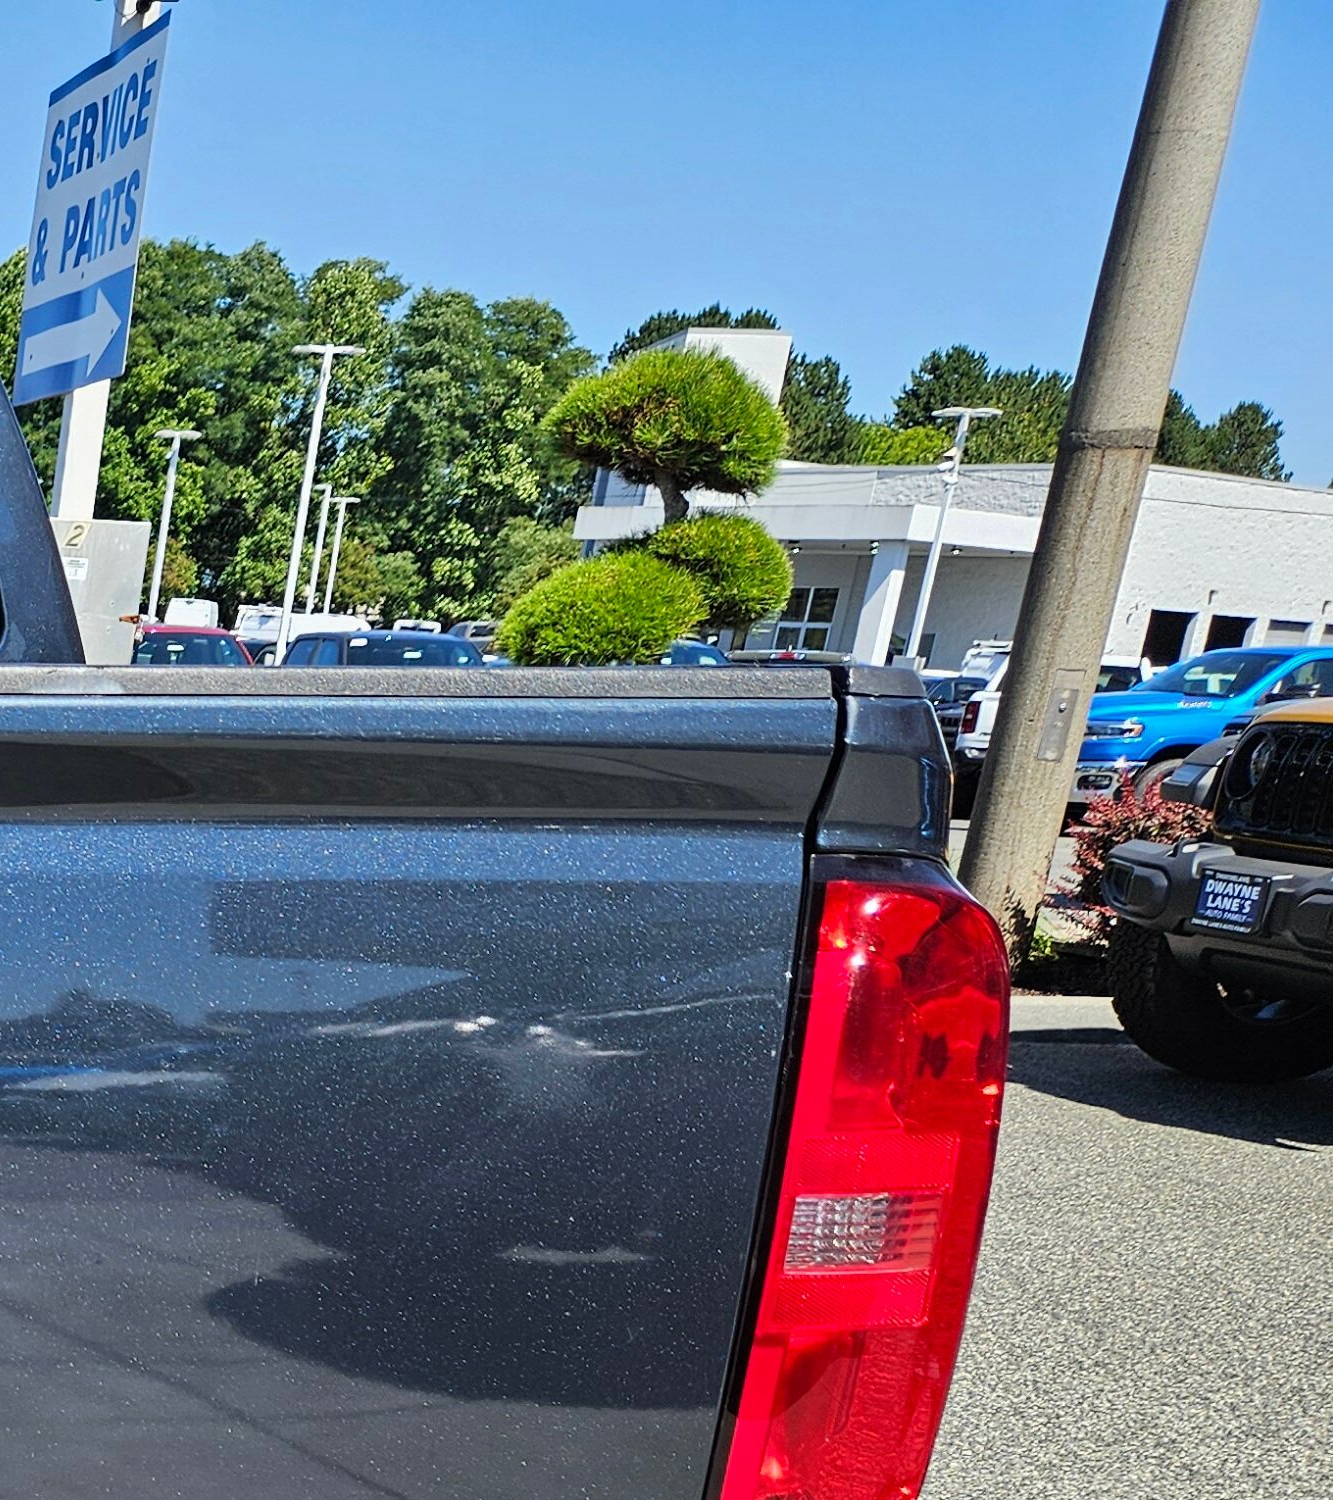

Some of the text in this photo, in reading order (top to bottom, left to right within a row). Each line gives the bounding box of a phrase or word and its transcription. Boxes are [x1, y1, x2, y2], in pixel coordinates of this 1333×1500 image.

[46, 60, 157, 189] SERVICE
[31, 169, 140, 286] & PARTS
[65, 525, 85, 547] 2
[1205, 879, 1261, 900] DWAYNE
[1206, 894, 1252, 913] LANE'S
